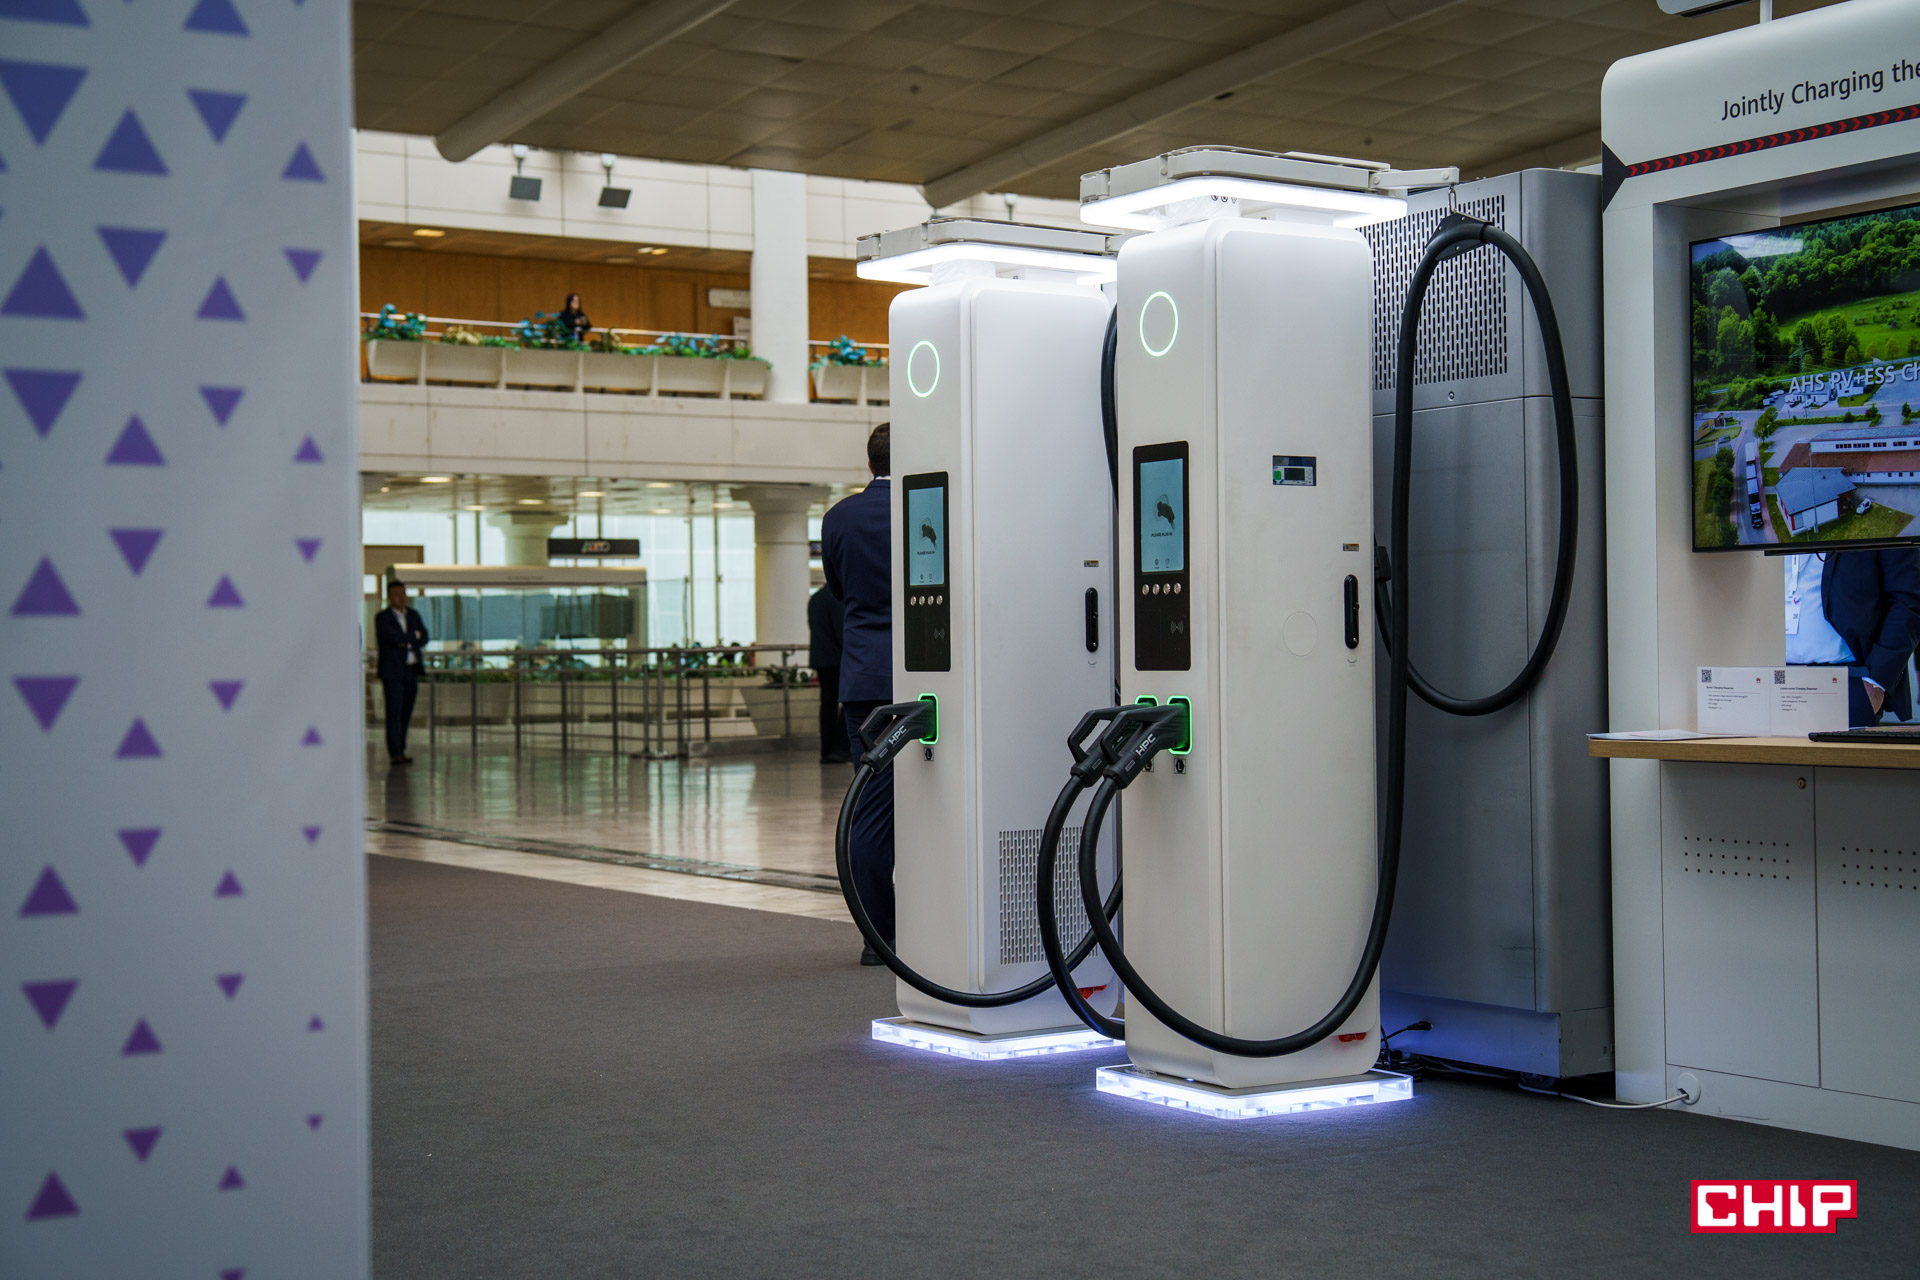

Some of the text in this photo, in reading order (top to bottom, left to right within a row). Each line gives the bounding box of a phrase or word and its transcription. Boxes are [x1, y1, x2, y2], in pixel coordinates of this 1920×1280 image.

[1721, 89, 1785, 120] Jointly
[1791, 70, 1884, 104] Charging
[1788, 373, 1825, 394] AHS
[1830, 365, 1896, 389] PV+ESS
[888, 725, 907, 745] HPC
[1135, 733, 1157, 756] HPC
